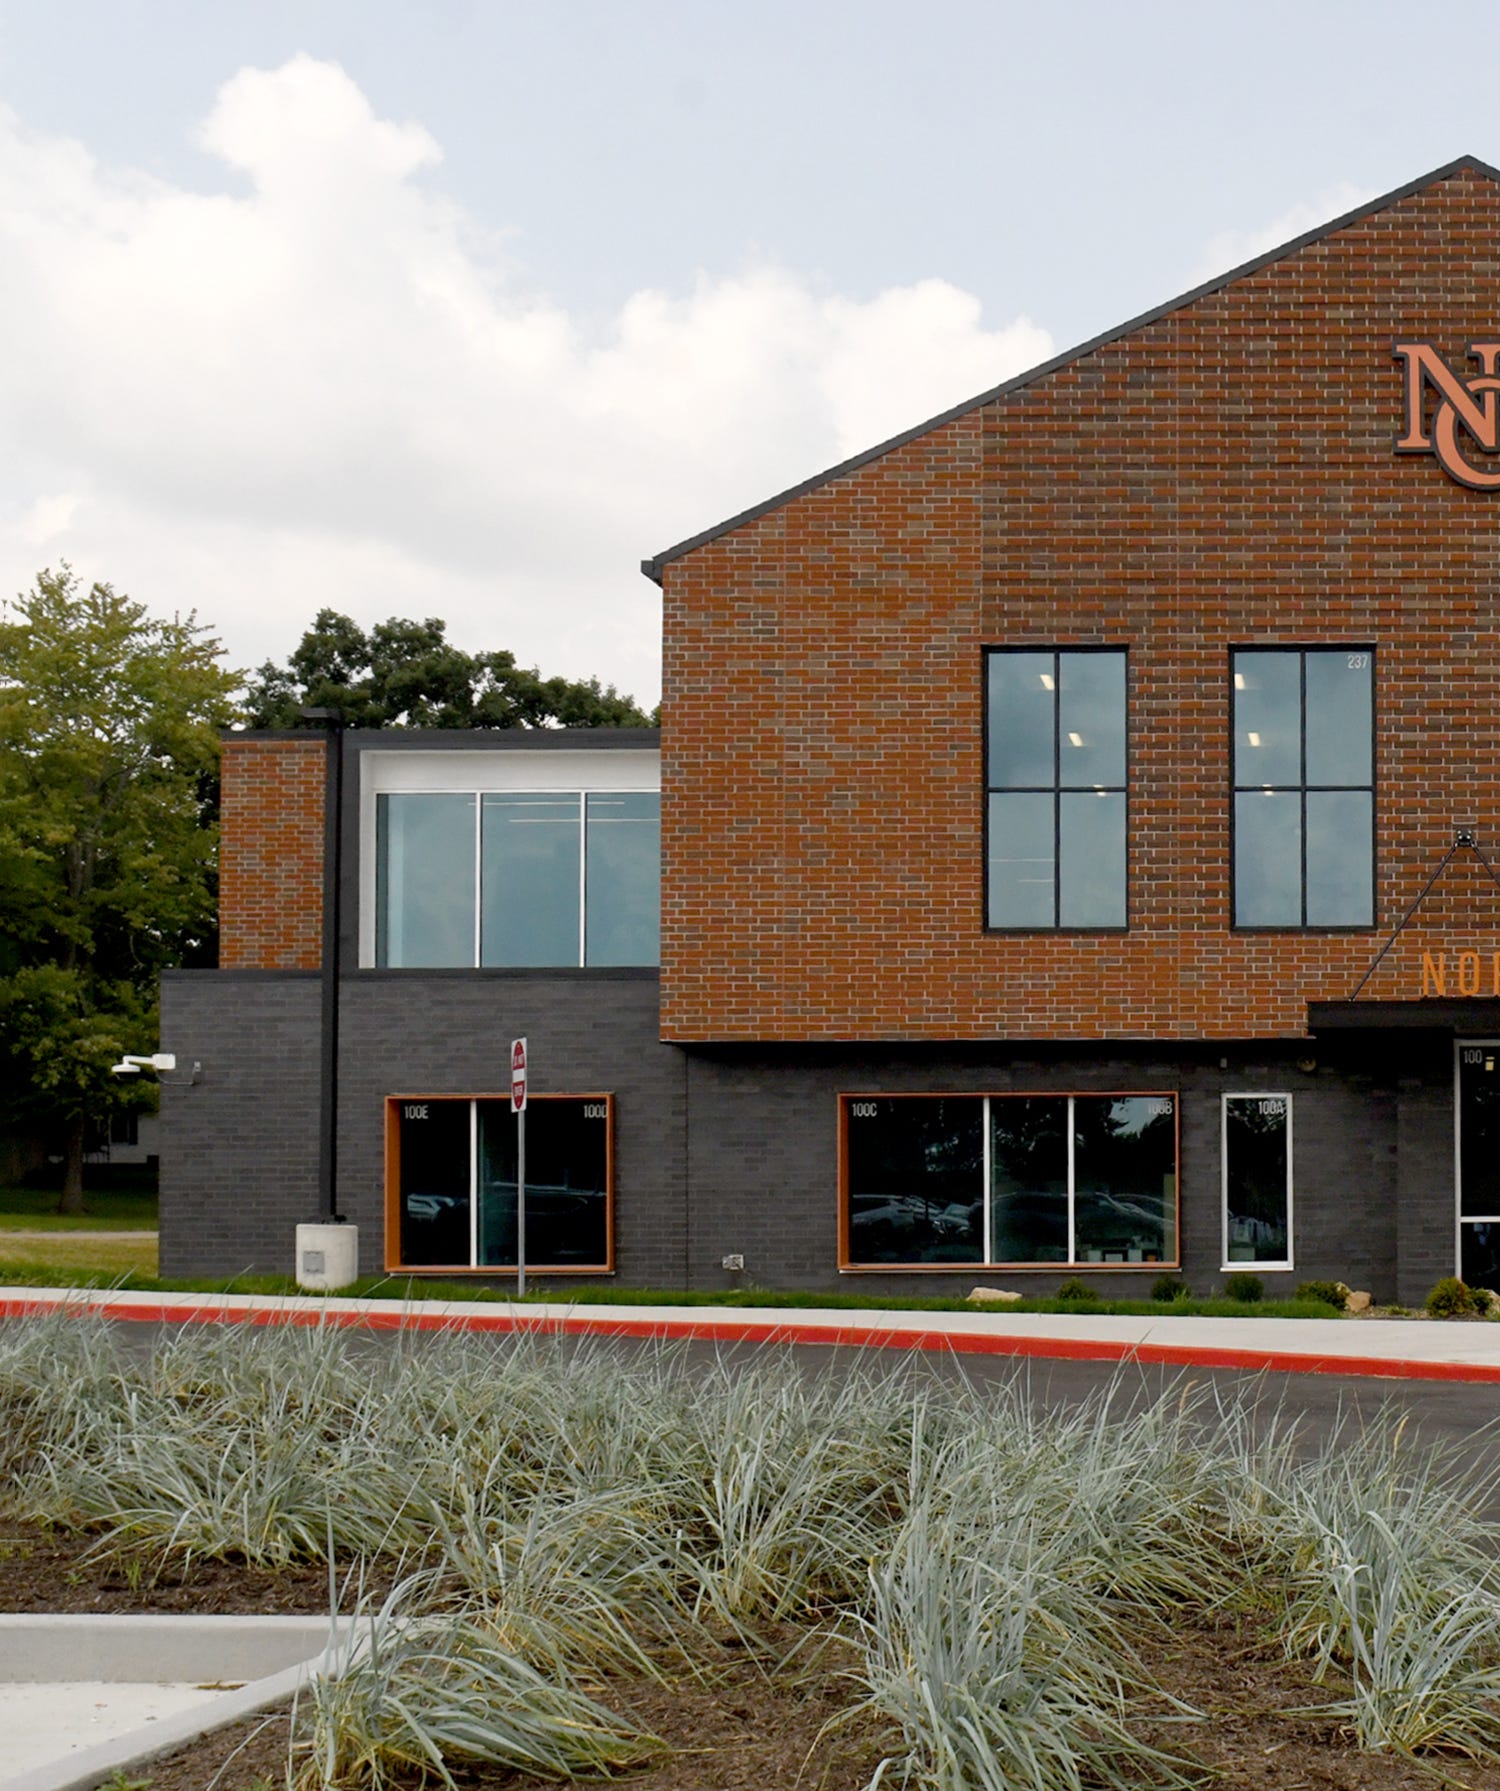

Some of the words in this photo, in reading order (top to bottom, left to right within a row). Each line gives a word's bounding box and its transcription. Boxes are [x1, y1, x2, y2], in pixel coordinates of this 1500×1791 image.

[1347, 654, 1368, 669] 237
[1464, 1049, 1482, 1064] 100
[404, 1104, 429, 1119] 100E
[852, 1102, 877, 1117] 100C
